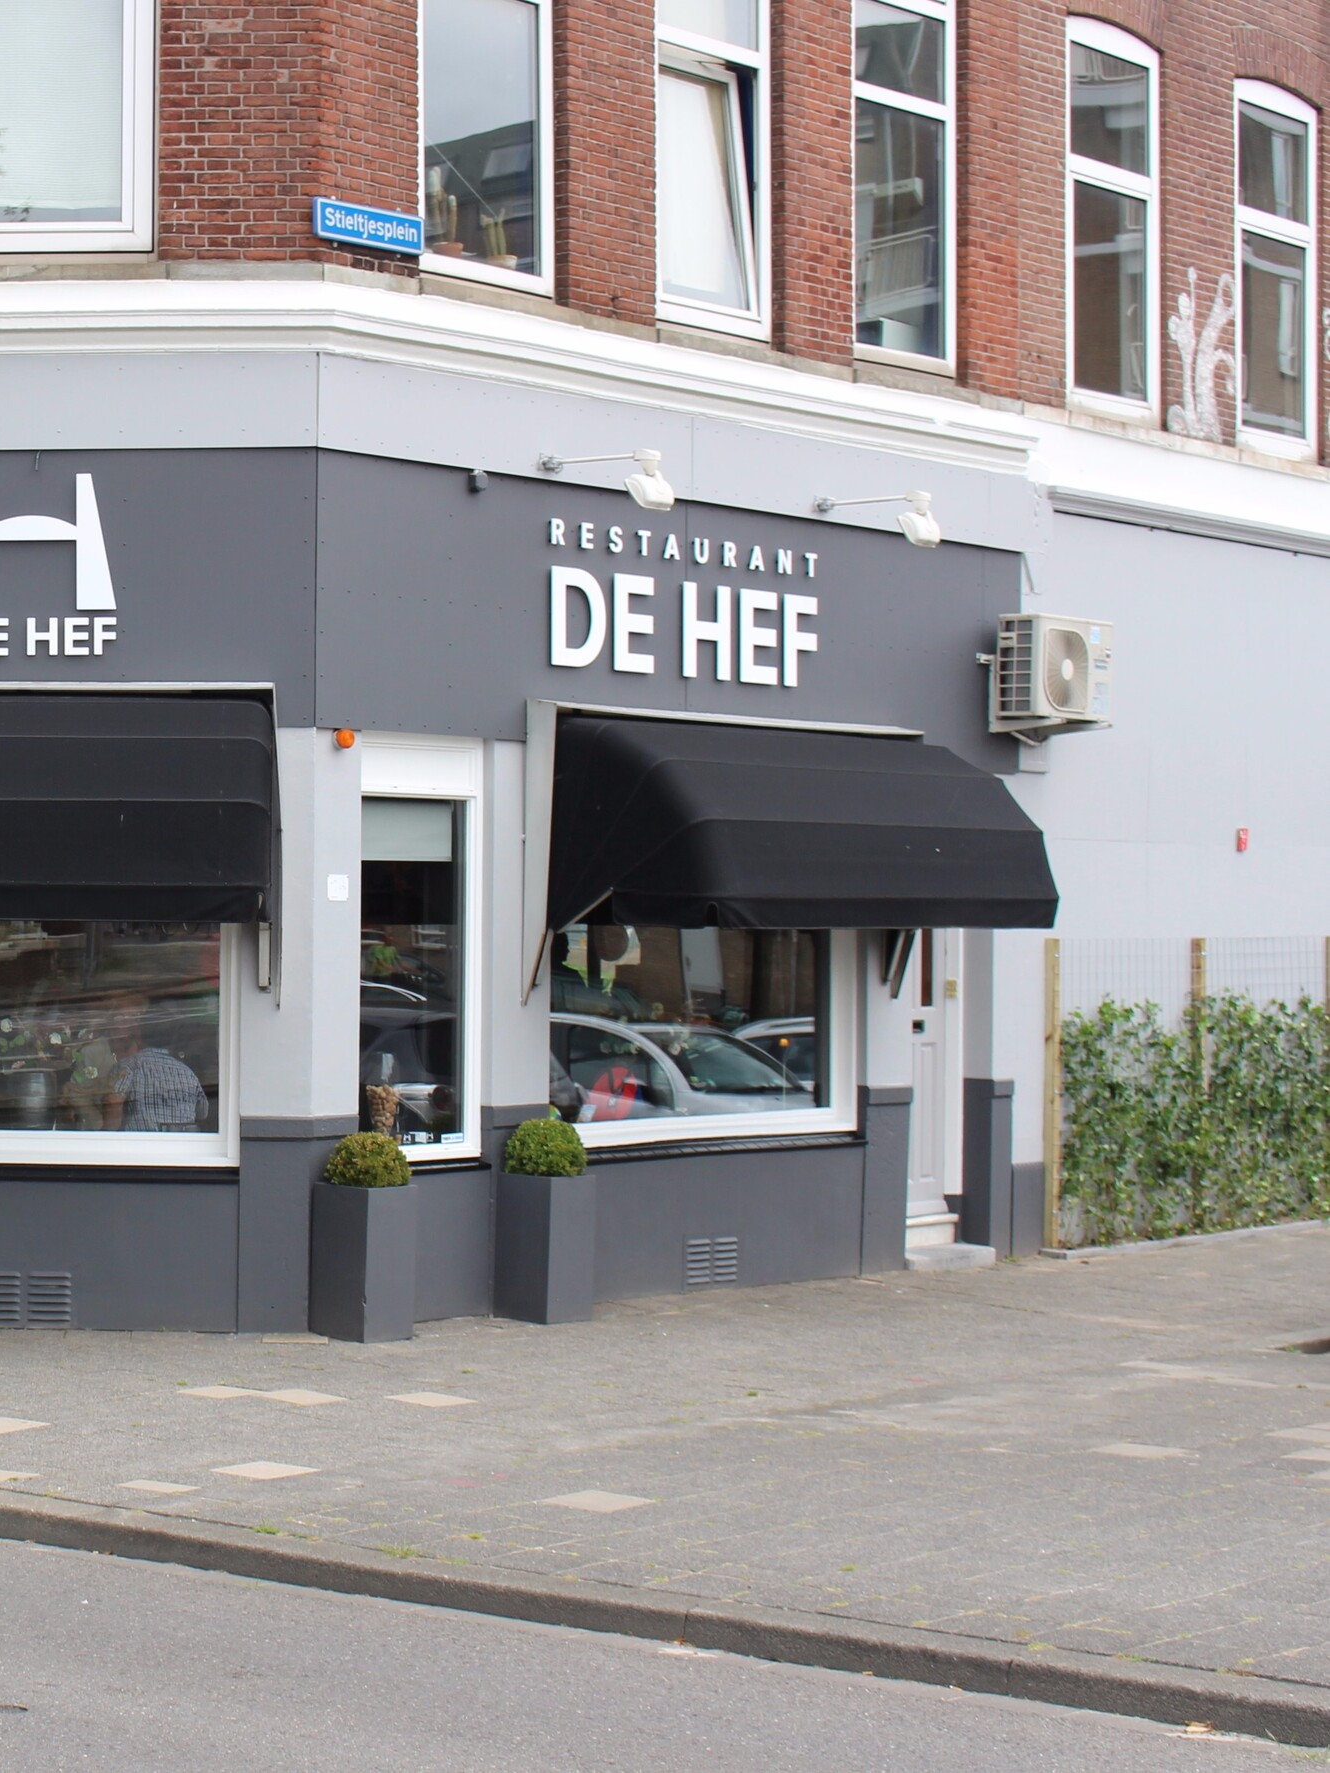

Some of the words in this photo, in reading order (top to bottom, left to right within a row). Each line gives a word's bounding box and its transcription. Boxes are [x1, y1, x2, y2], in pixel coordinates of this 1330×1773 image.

[324, 207, 418, 243] Stieltjesplein
[549, 517, 819, 578] RESTAURANT
[26, 616, 117, 656] HEF
[549, 565, 655, 675] DE
[681, 580, 819, 688] HEF
